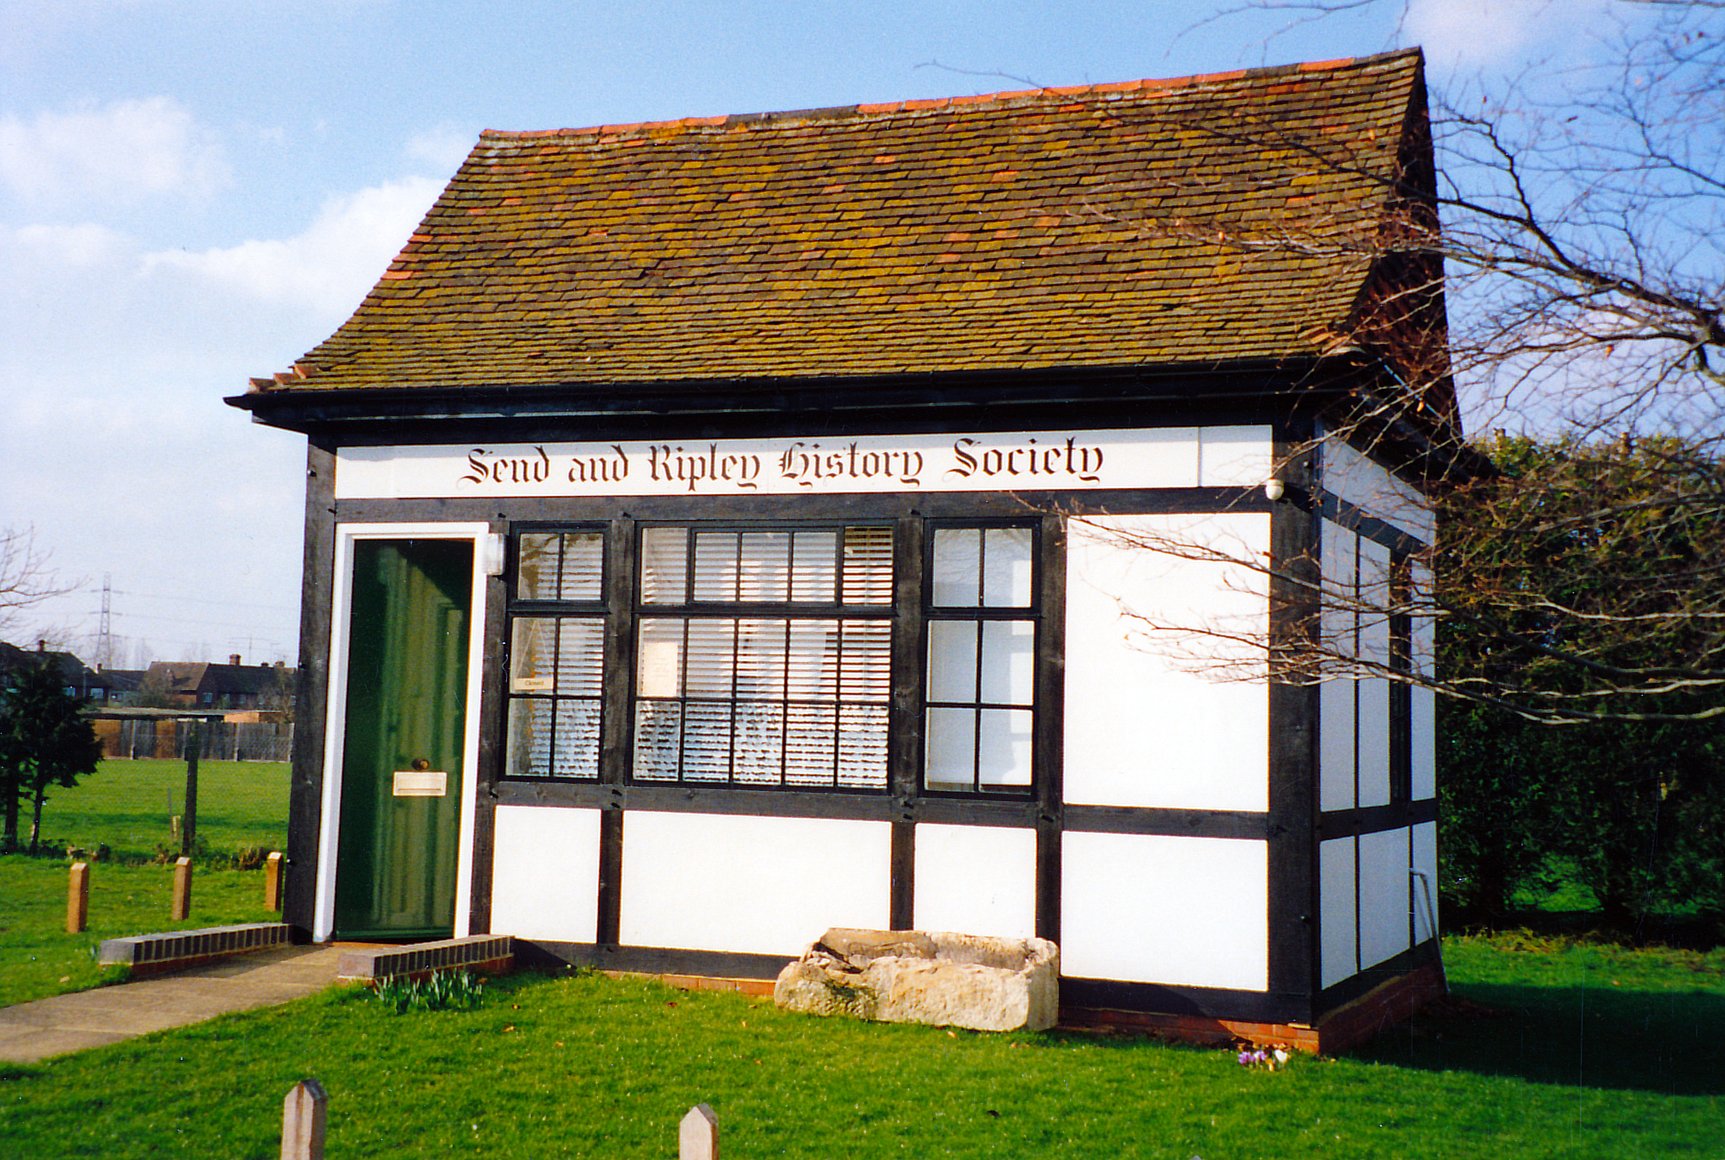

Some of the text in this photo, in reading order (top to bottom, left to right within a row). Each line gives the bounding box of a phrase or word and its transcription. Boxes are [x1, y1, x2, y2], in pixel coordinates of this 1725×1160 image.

[459, 436, 1104, 491] Send and Ripley History Society
